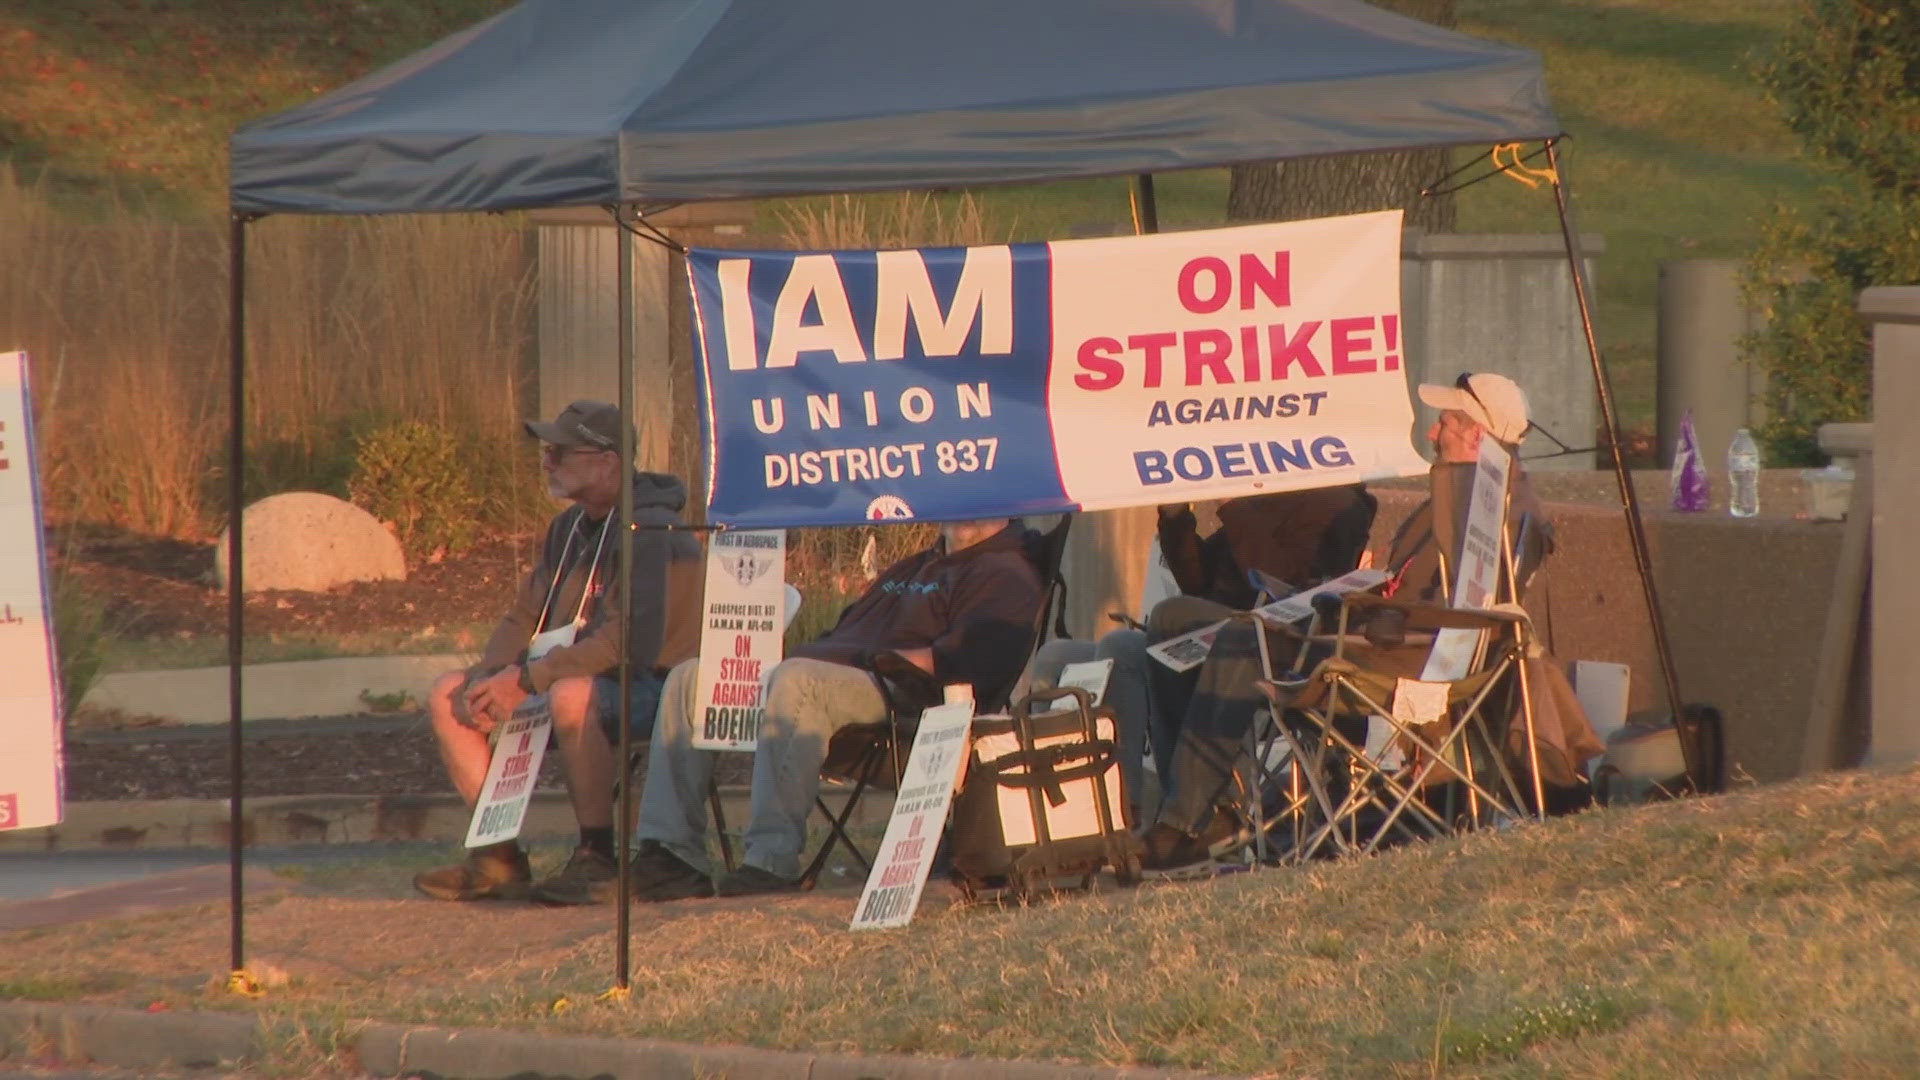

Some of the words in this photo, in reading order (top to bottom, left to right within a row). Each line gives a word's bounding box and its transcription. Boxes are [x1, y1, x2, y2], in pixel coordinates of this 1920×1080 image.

[1177, 250, 1291, 315] ON
[717, 246, 1013, 371] IAM
[1074, 314, 1399, 392] STRIKE!
[751, 381, 992, 434] UNION
[1146, 391, 1328, 428] AGAINST
[764, 439, 924, 489] DISTRICT
[935, 437, 1000, 474] 837
[1133, 435, 1356, 487] BOEING
[710, 603, 746, 615] AEROSPACE
[734, 634, 752, 658] ON
[720, 658, 761, 682] STRIKE
[711, 683, 763, 708] AGAINST
[891, 836, 926, 863] STRIKE
[878, 861, 922, 889] AGAINST
[861, 885, 916, 923] BOEING
